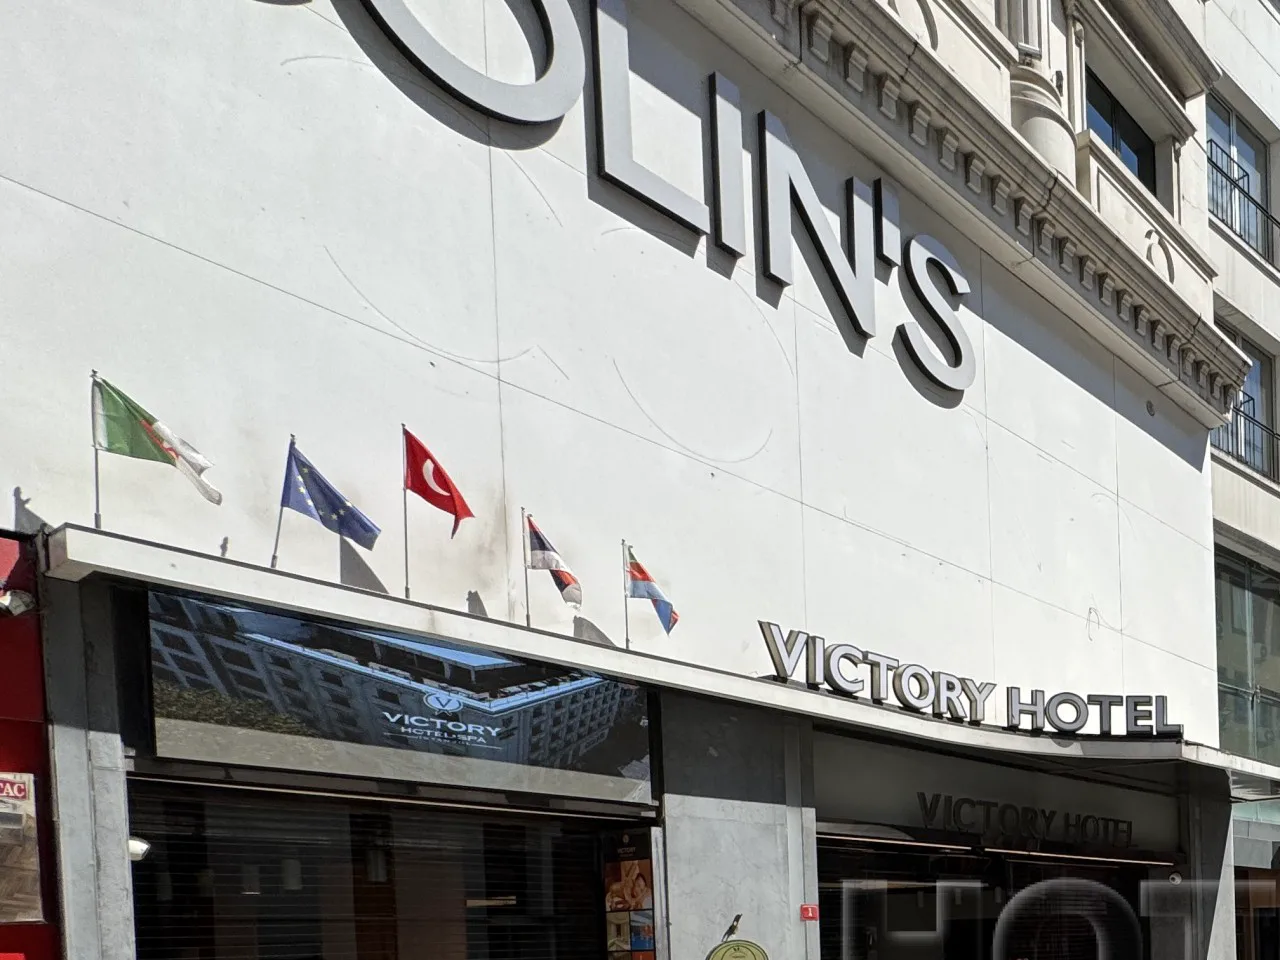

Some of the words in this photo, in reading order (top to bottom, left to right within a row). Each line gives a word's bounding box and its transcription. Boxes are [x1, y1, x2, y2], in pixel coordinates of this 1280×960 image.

[757, 620, 997, 725] VICTORY
[1005, 686, 1184, 736] HOTEL
[382, 711, 502, 737] VICTORY
[916, 791, 1056, 842] VICTORY
[1063, 813, 1137, 848] HOTEL
